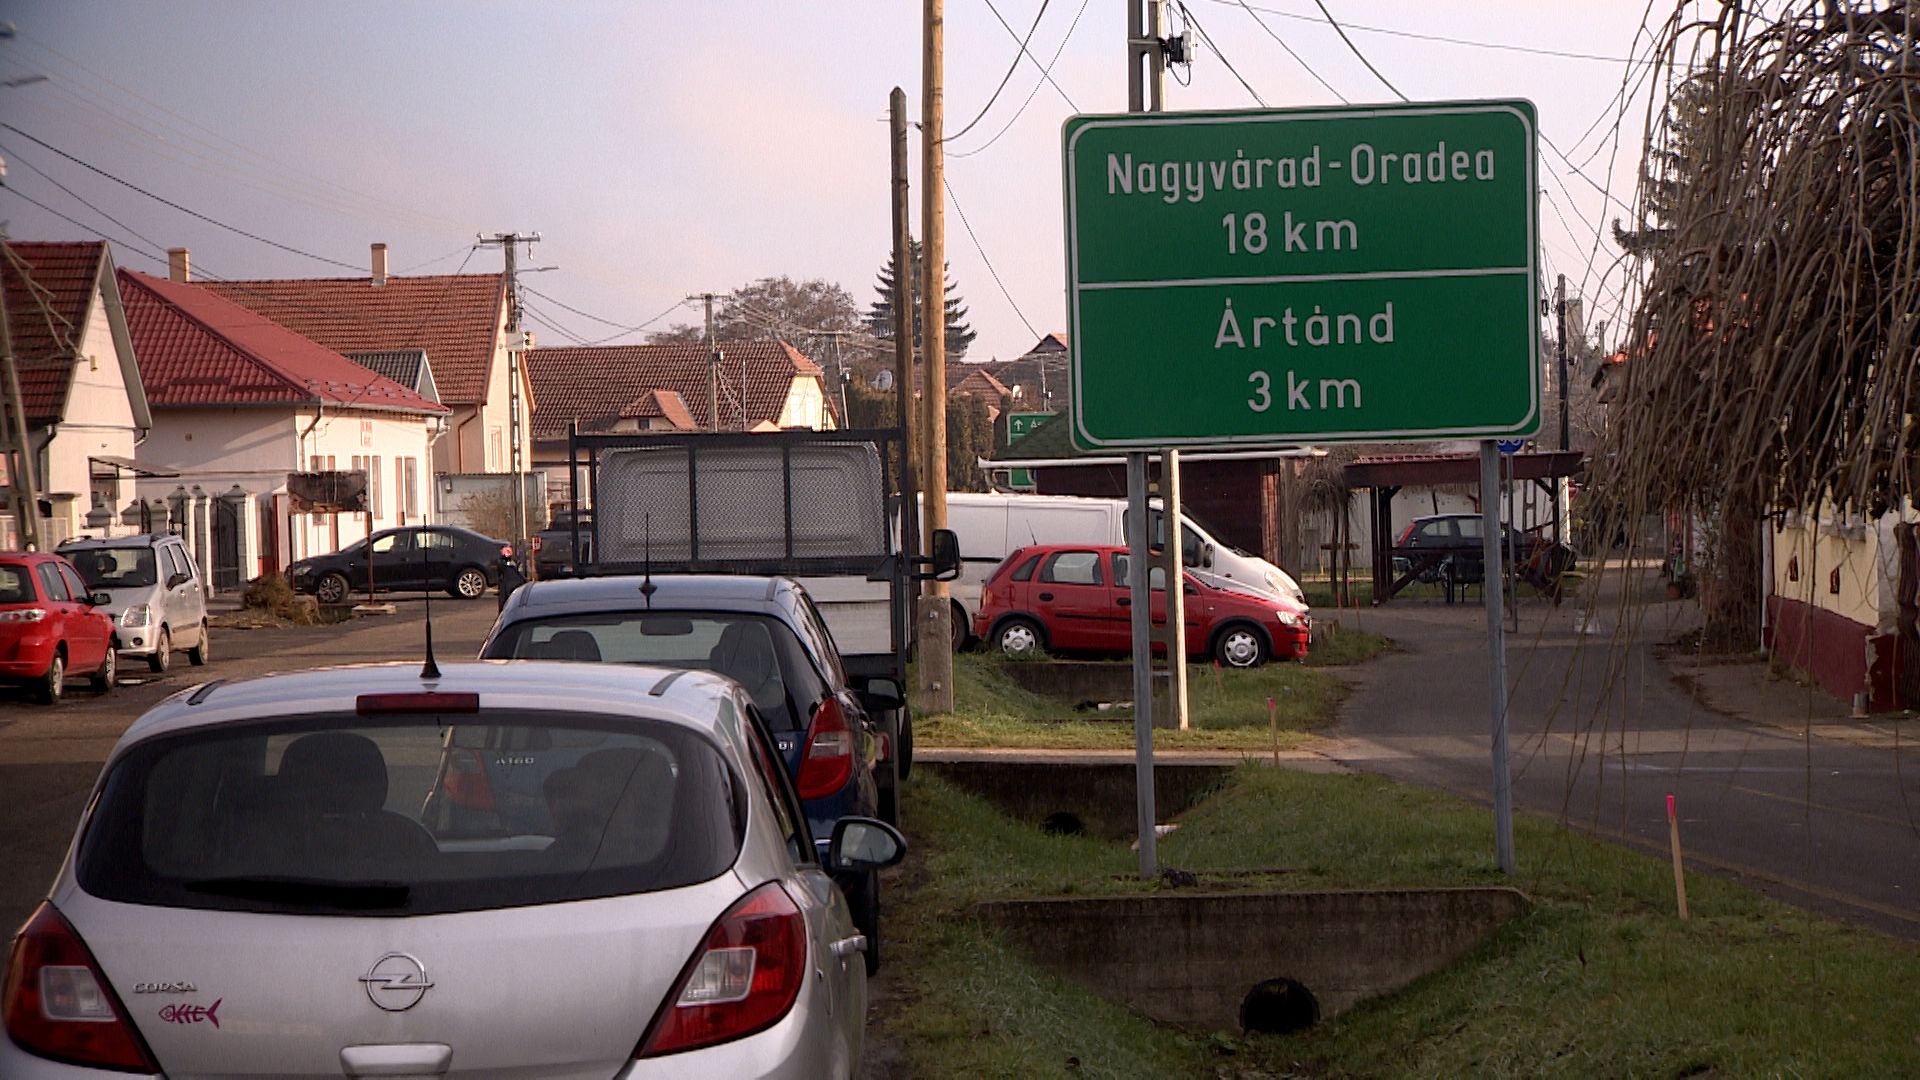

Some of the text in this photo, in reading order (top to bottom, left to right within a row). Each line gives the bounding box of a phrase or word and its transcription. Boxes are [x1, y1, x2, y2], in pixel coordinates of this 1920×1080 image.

[1107, 141, 1495, 203] Nagyvárad-Oradea
[1222, 211, 1358, 254] 18 km
[1214, 298, 1395, 348] Ártánd
[1247, 370, 1361, 412] 3 km
[133, 982, 198, 994] CORSA
